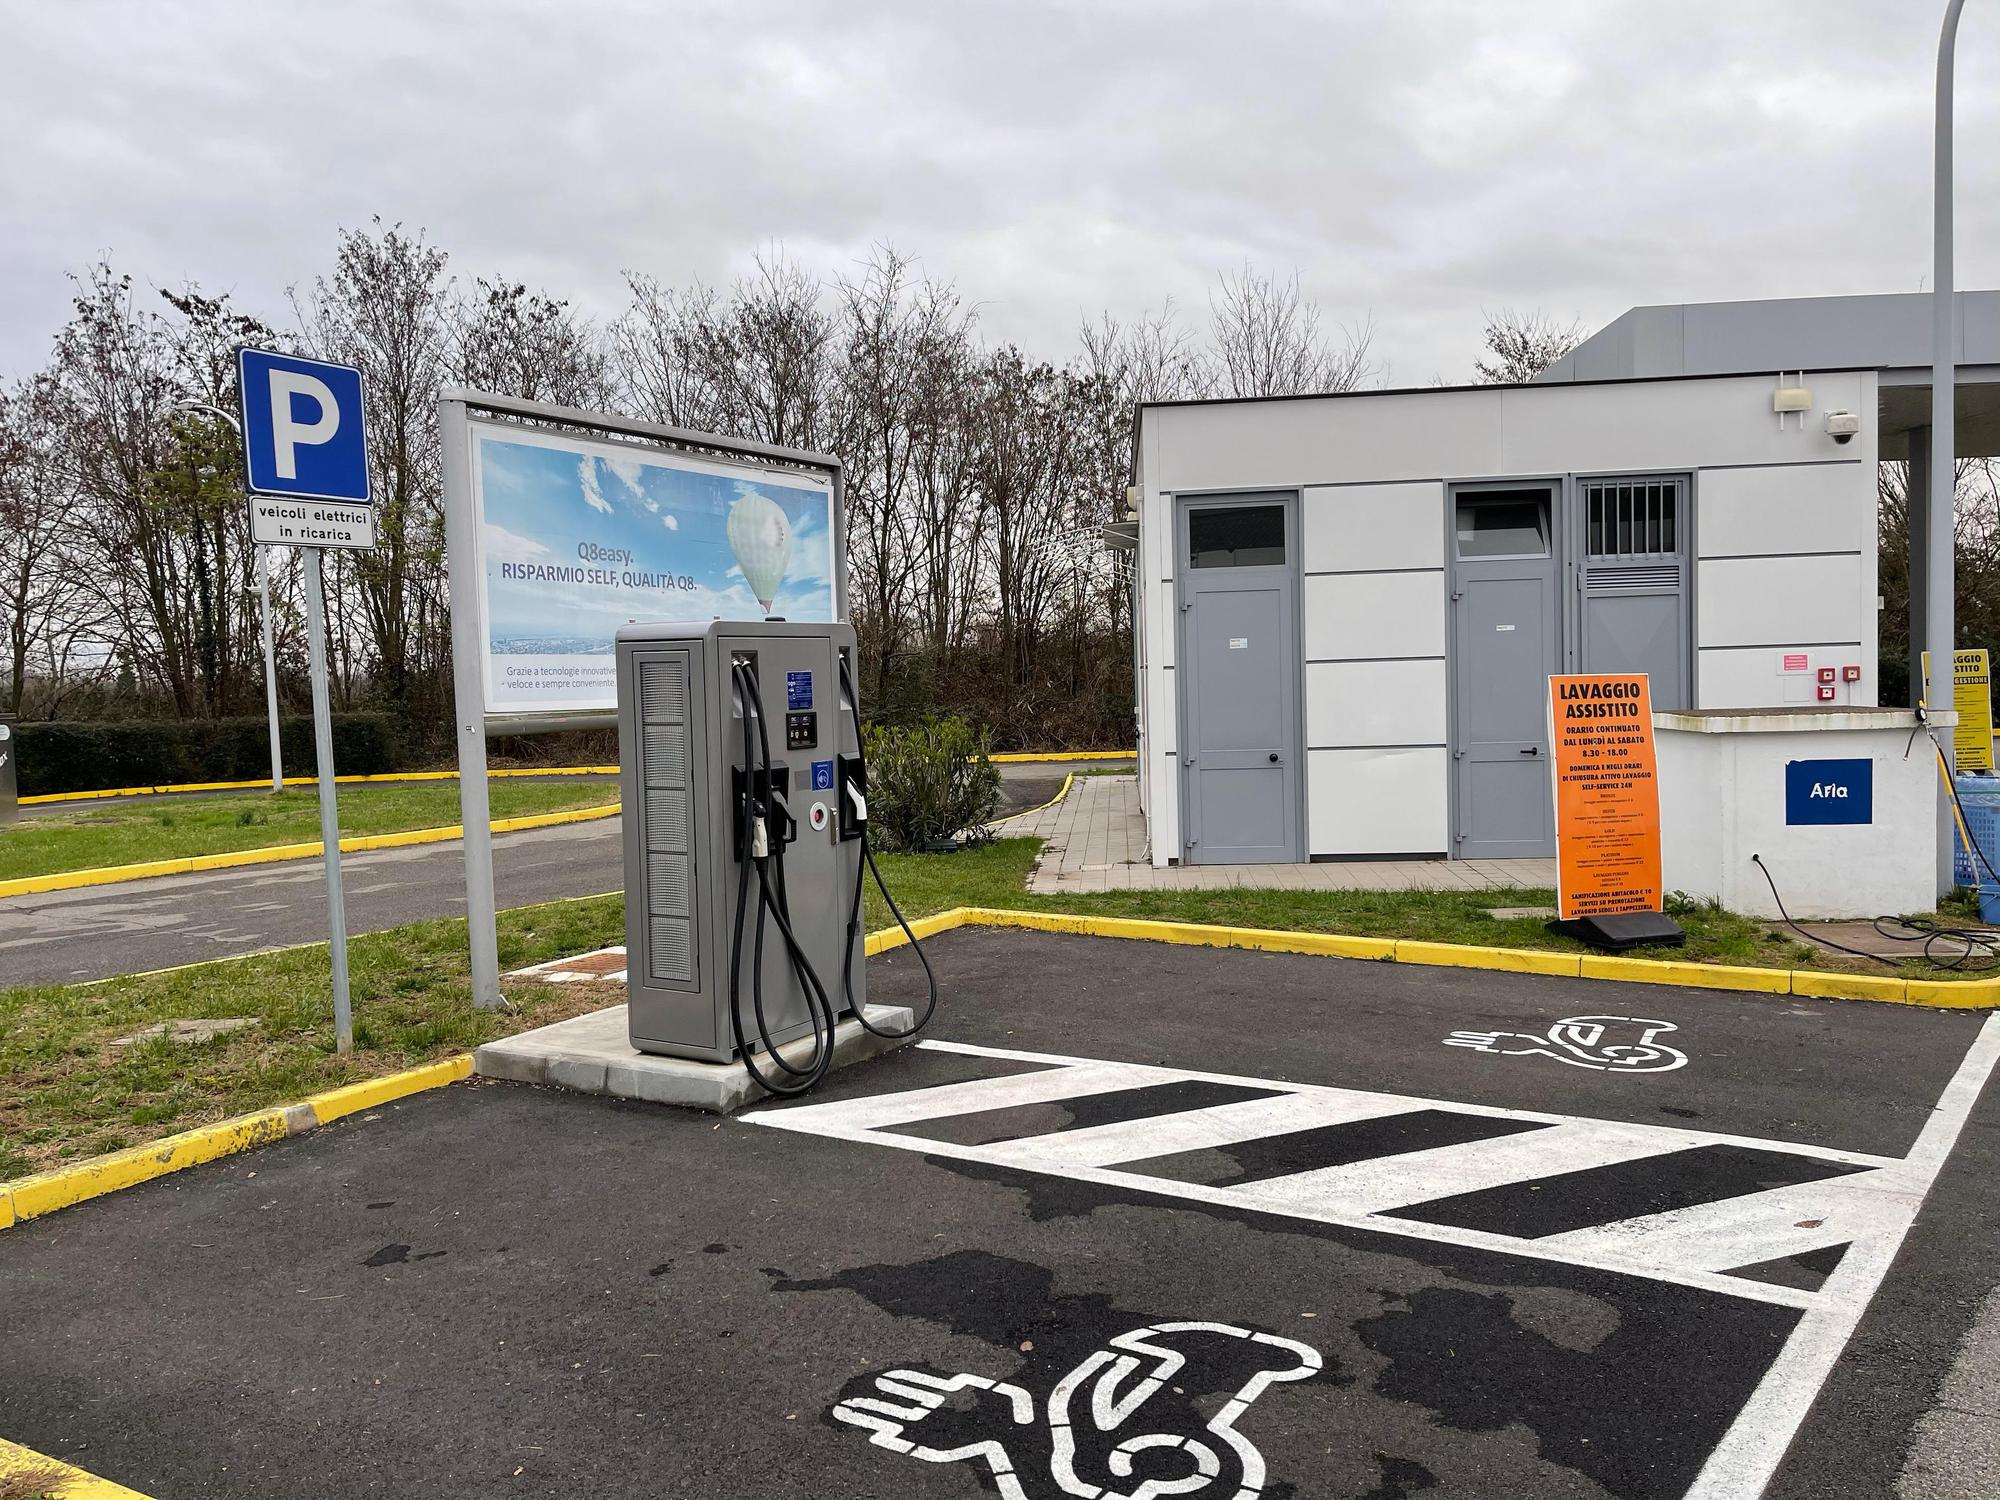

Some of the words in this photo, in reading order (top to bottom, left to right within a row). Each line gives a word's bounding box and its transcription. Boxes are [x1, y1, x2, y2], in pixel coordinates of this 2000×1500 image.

[269, 368, 340, 480] P
[259, 506, 306, 520] veicoli
[314, 510, 367, 524] elettrici
[280, 525, 293, 537] in
[300, 527, 352, 541] ricarica
[577, 541, 634, 567] Q8easy.
[502, 562, 585, 584] RISPARMIO
[587, 568, 620, 589] SELF,
[622, 571, 676, 590] QUALITÀ
[678, 575, 698, 592] Q8.
[506, 666, 532, 676] Grazie
[533, 668, 539, 676] a
[540, 666, 580, 678] tecnologie
[507, 679, 533, 689] veloce
[542, 680, 570, 690] sempre
[1560, 683, 1641, 700] LAVAGGIO
[1566, 702, 1639, 719] ASSISTITO
[1566, 726, 1594, 735] ORARIO
[1596, 724, 1640, 733] CONTINUATO
[1563, 738, 1577, 746] DAL
[1617, 736, 1645, 744] SABATO
[1607, 748, 1628, 756] 18.00
[1569, 763, 1600, 772] DOMENICA
[1569, 773, 1600, 781] CHIUSURA
[1581, 783, 1619, 791] SELF-SERVICE
